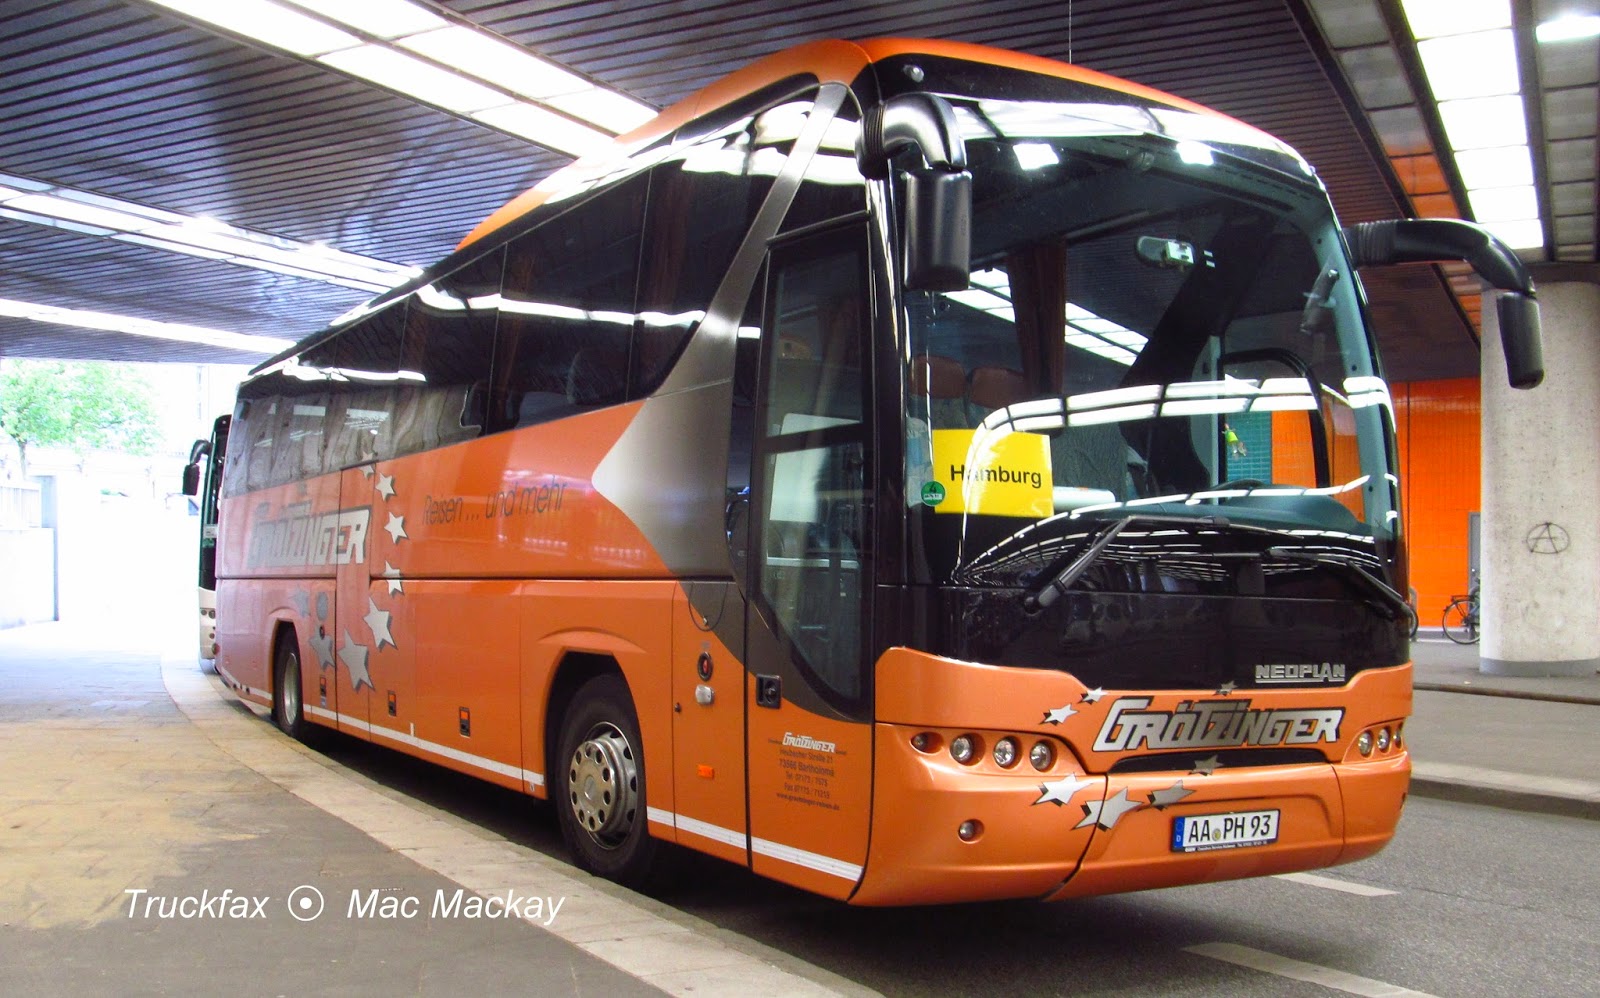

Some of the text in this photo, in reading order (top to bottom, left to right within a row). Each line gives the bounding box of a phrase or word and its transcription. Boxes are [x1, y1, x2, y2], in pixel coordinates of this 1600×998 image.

[485, 482, 519, 519] und
[518, 475, 568, 514] mehr
[1255, 662, 1346, 683] NEOPLAN
[1188, 819, 1211, 843] AA
[1223, 816, 1246, 840] PH
[1250, 814, 1272, 838] 93
